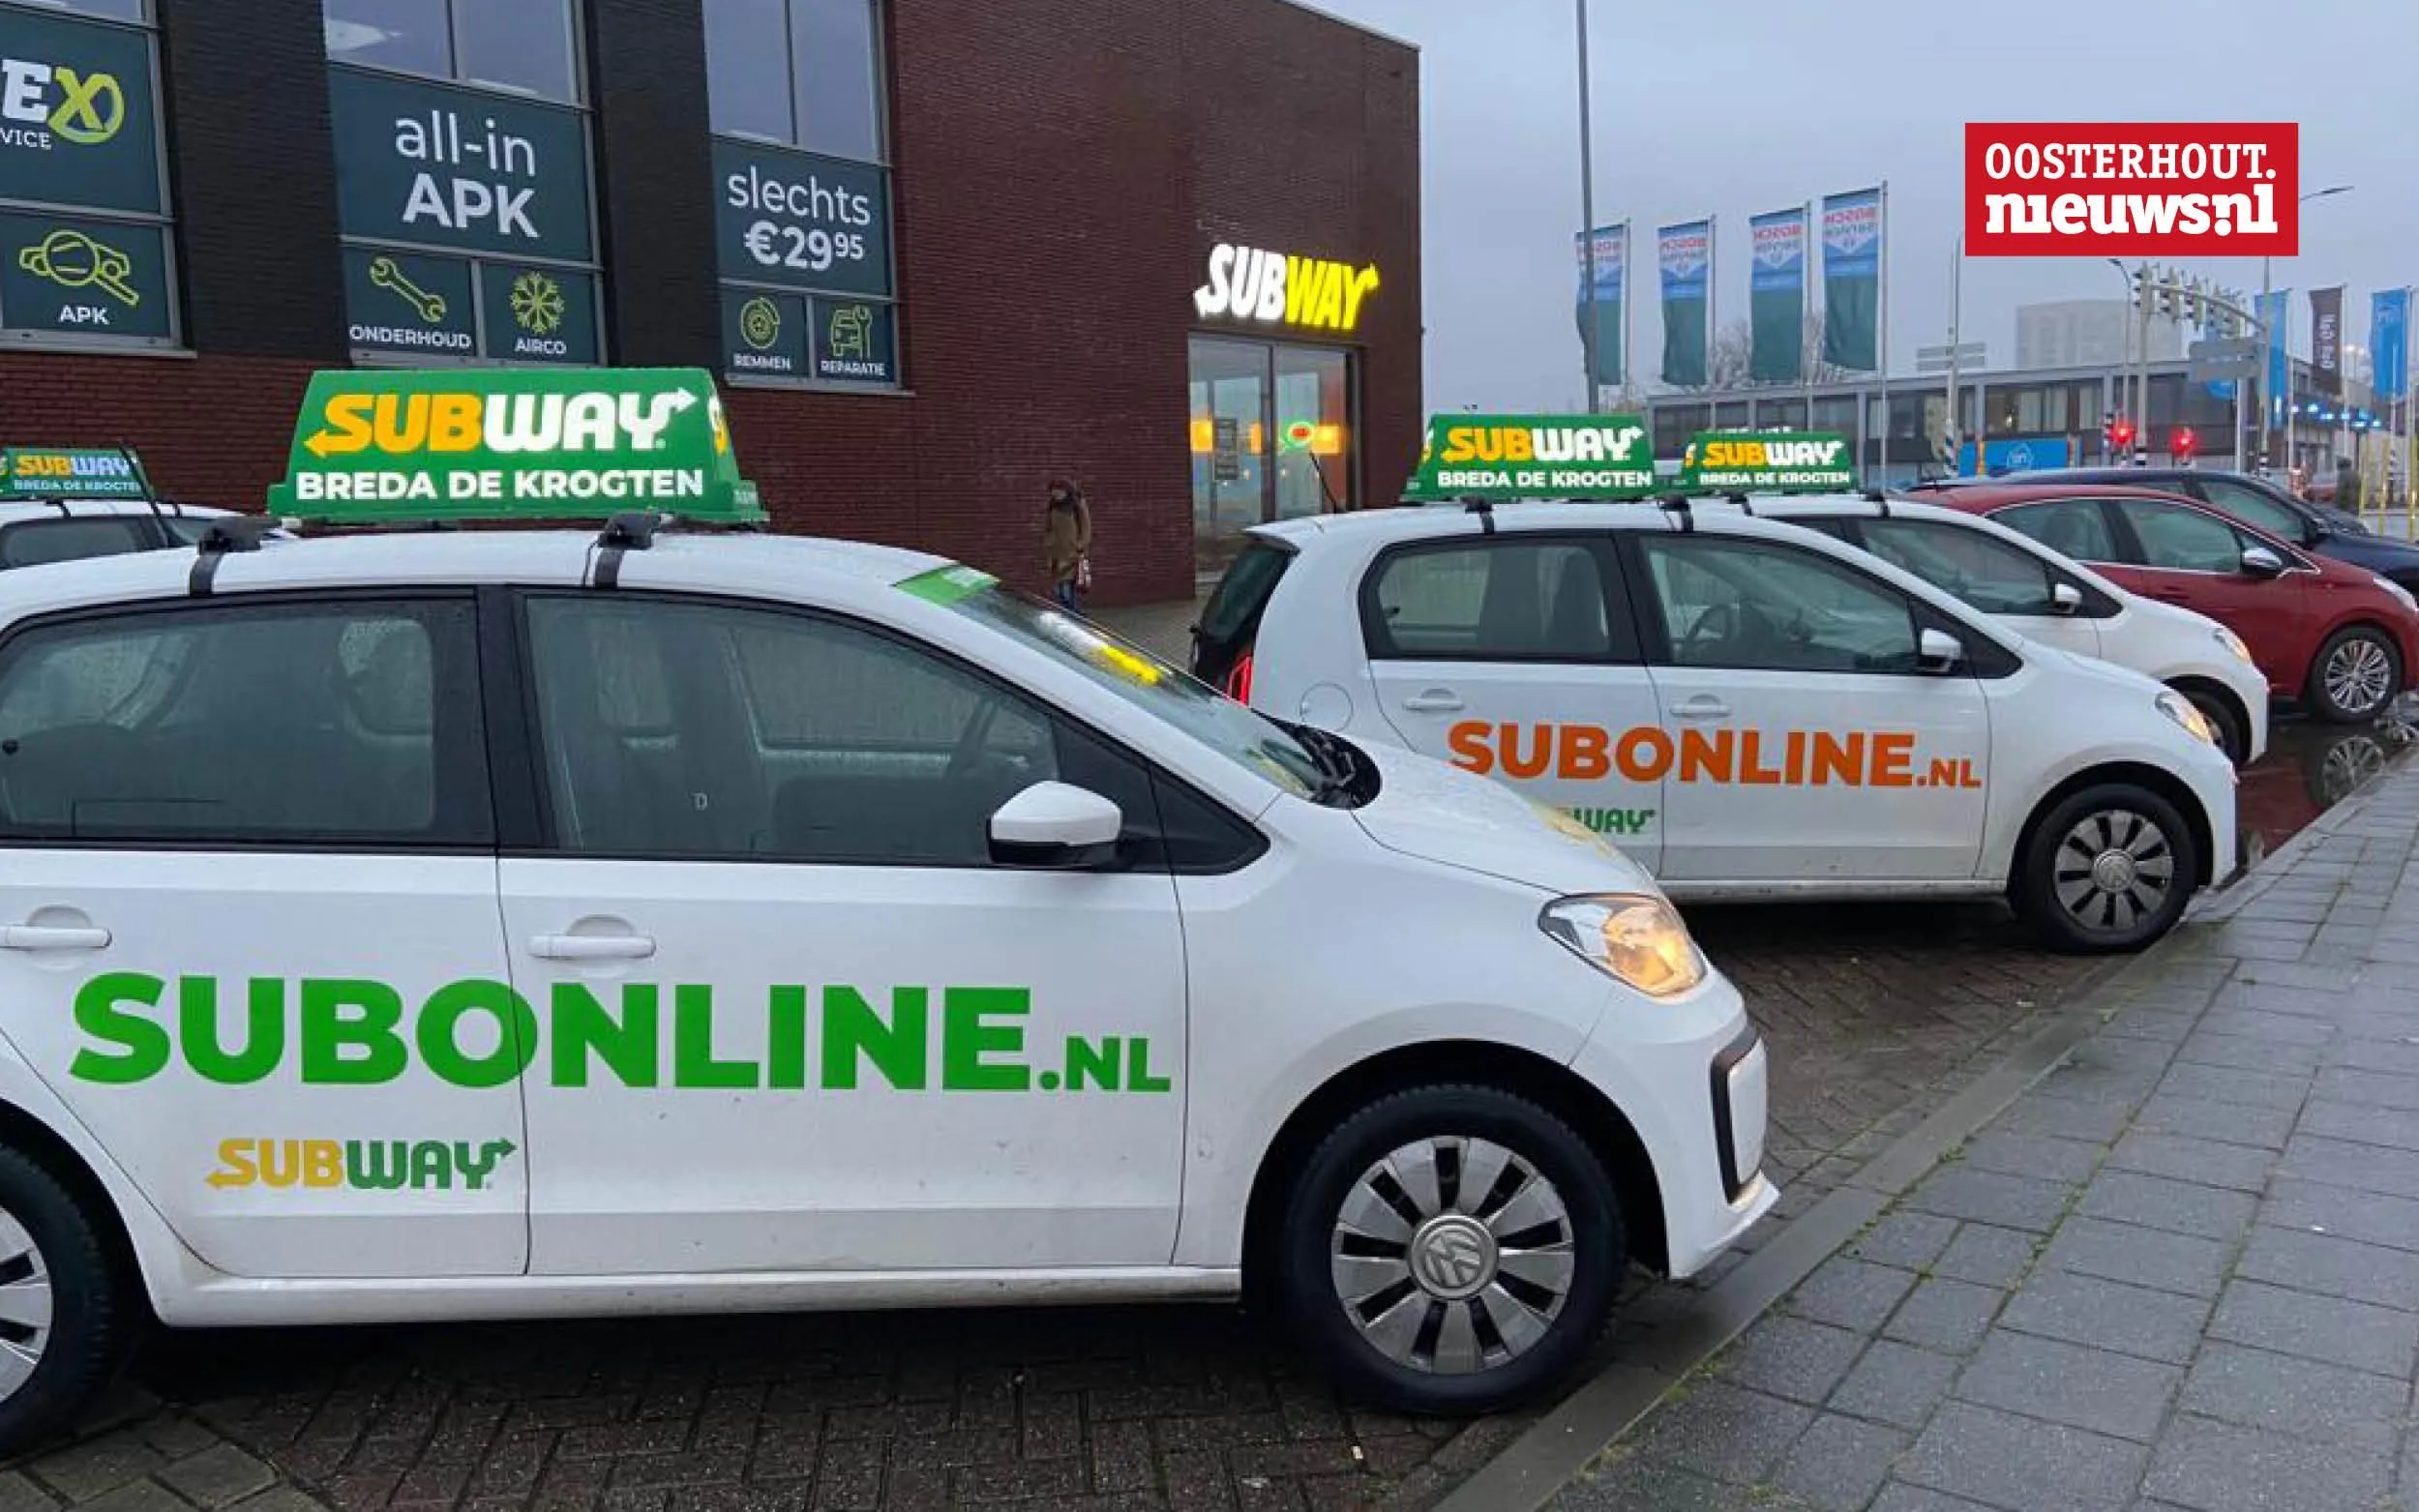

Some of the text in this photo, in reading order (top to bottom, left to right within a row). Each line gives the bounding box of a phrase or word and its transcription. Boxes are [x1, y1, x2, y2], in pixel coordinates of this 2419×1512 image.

[395, 110, 536, 176] all-in
[402, 173, 539, 239] APK
[728, 165, 871, 226] slechts
[1193, 242, 1380, 330] SUBWAY
[58, 305, 108, 325] APK
[349, 325, 471, 349] ONDERHOUD
[514, 337, 567, 355] AIRCO
[733, 353, 791, 371] REMMEN
[821, 360, 885, 376] REPARATIE
[304, 389, 698, 457] SUBWAY
[1442, 426, 1643, 462] SUBWAY
[1702, 440, 1843, 467] SUBWAY
[14, 455, 132, 478] SUBWAY
[1438, 470, 1652, 488] BREDA DE KROGTEN
[1700, 472, 1850, 485] BREDA DE KROGTEN
[14, 479, 61, 491] BREDA
[64, 480, 81, 491] DE
[296, 470, 432, 501] BREDA
[441, 470, 504, 499] DE
[514, 469, 704, 500] KROGTEN
[1447, 720, 1983, 788] SUBONLINE.NL
[70, 972, 1171, 1093] SUBONLINE.NL
[205, 1138, 517, 1190] SUBWAY
